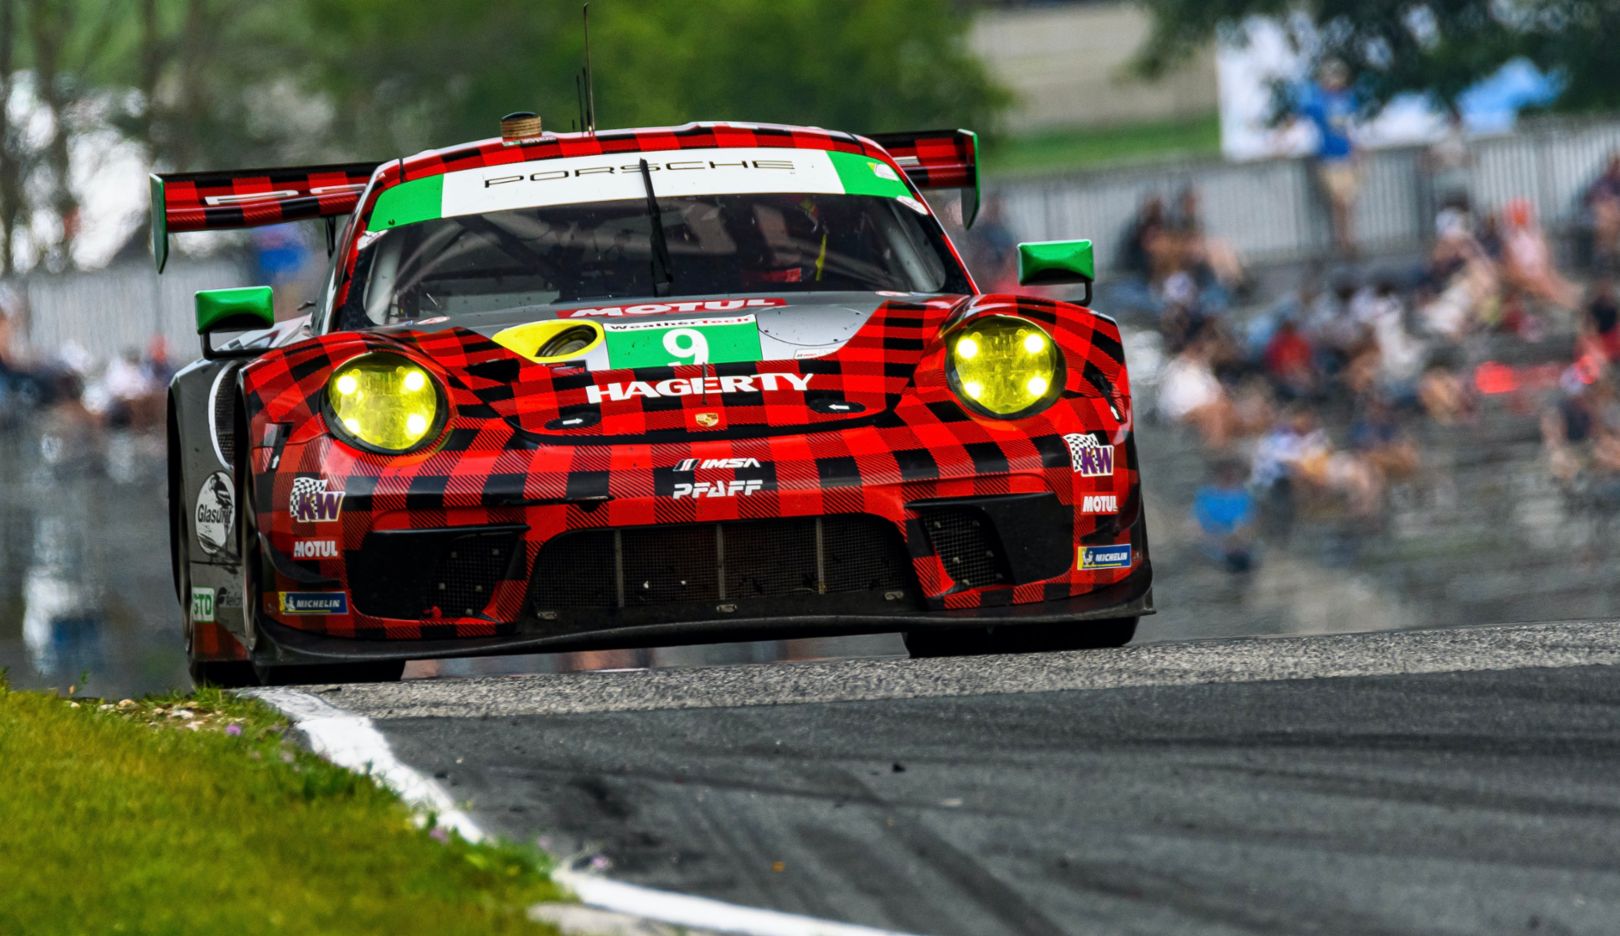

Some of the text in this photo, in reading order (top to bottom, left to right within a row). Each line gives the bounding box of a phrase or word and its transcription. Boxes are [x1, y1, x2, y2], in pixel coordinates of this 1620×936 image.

[485, 160, 795, 188] PORSCHE
[570, 299, 775, 317] MOTUL
[610, 317, 749, 329] WeatherTech
[662, 328, 709, 367] 9
[586, 372, 814, 404] HAGERTY
[700, 458, 760, 469] IMSA
[1080, 446, 1112, 475] KW
[673, 479, 763, 500] PFAFF
[297, 492, 345, 521] KW
[1083, 495, 1118, 512] MOTUL
[293, 540, 338, 557] MOTUL
[1095, 552, 1128, 562] MICHELIN
[296, 599, 341, 608] MICHELIN
